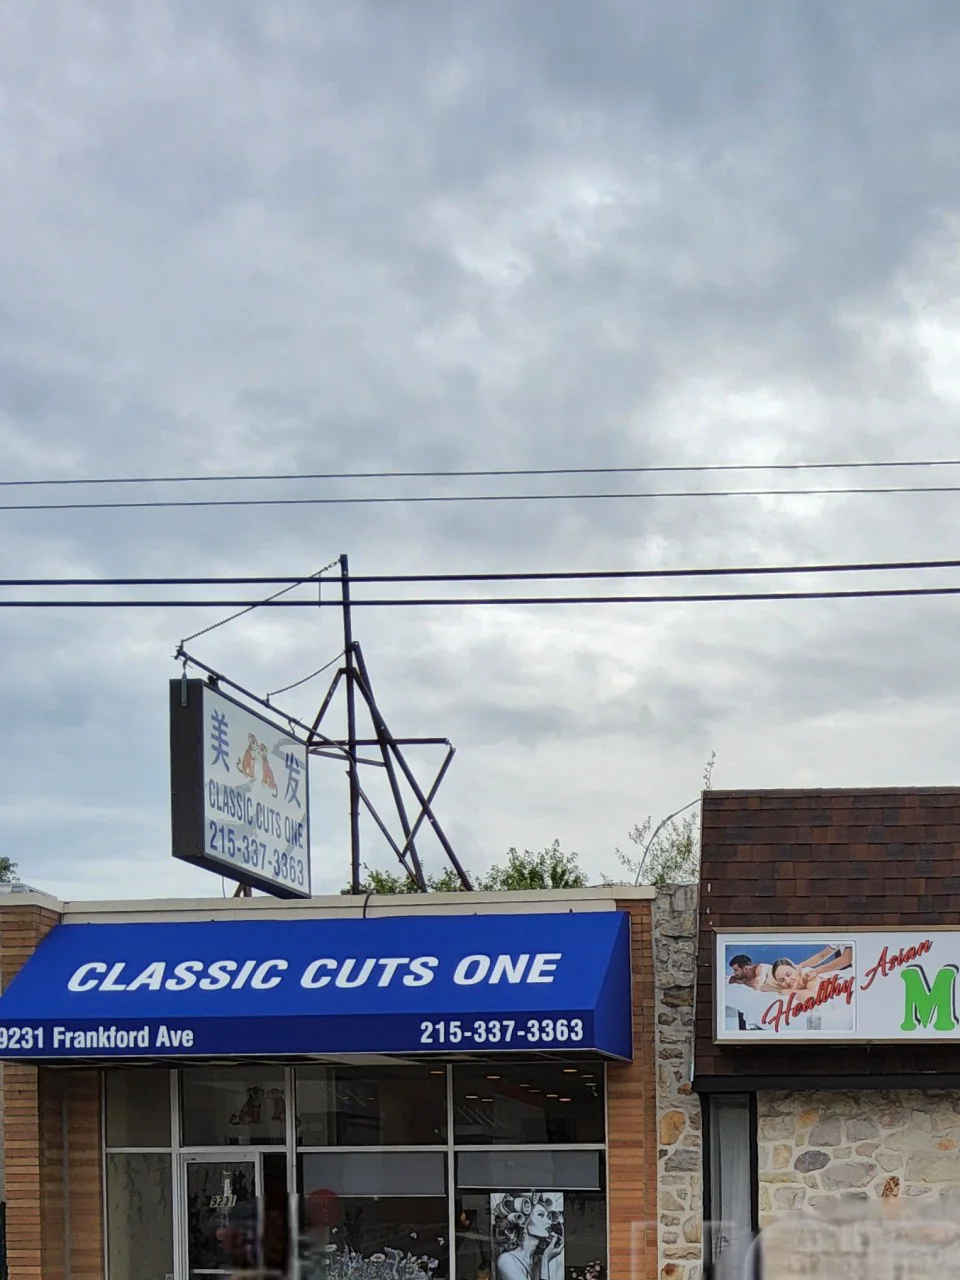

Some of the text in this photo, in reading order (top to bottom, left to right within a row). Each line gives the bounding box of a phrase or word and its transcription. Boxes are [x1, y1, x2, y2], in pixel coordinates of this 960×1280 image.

[208, 778, 304, 850] CLASSIC CUTS ONE
[209, 822, 304, 888] 215-337-3363
[67, 952, 563, 992] CLASSIC CUTS ONE
[860, 939, 934, 991] Asian
[761, 972, 855, 1033] Healthy
[0, 1025, 194, 1049] 9231 Frankford Ave
[420, 1019, 585, 1045] 215-337-3363
[211, 1196, 235, 1207] 9231
